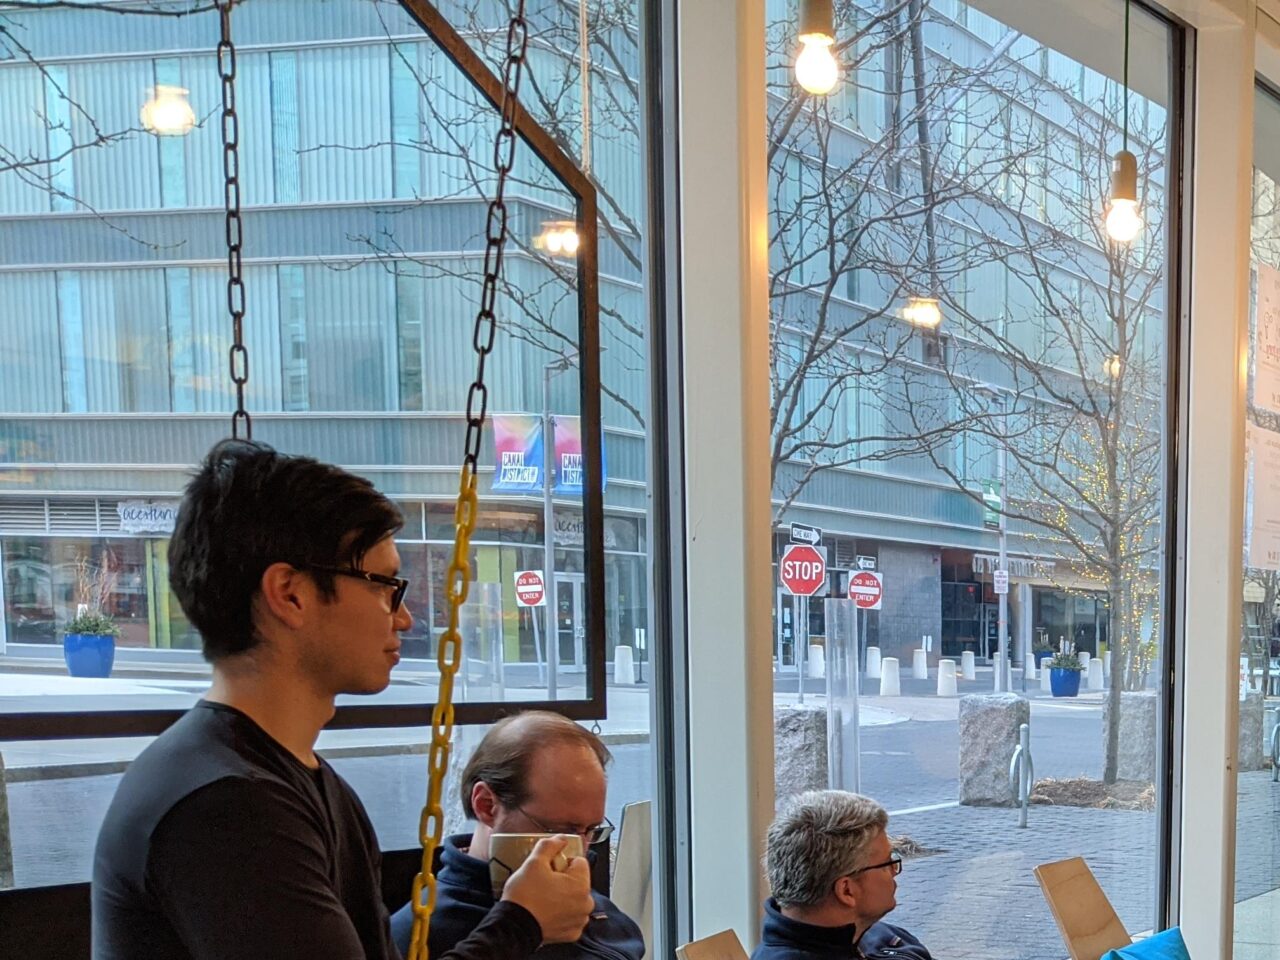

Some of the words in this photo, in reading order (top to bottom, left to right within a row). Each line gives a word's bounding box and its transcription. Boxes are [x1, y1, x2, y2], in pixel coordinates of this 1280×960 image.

[563, 455, 583, 468] CANA
[794, 529, 804, 538] ONE
[784, 561, 822, 580] STOP
[518, 577, 527, 585] DO
[522, 592, 539, 600] ENTER
[855, 594, 875, 602] ENTER
